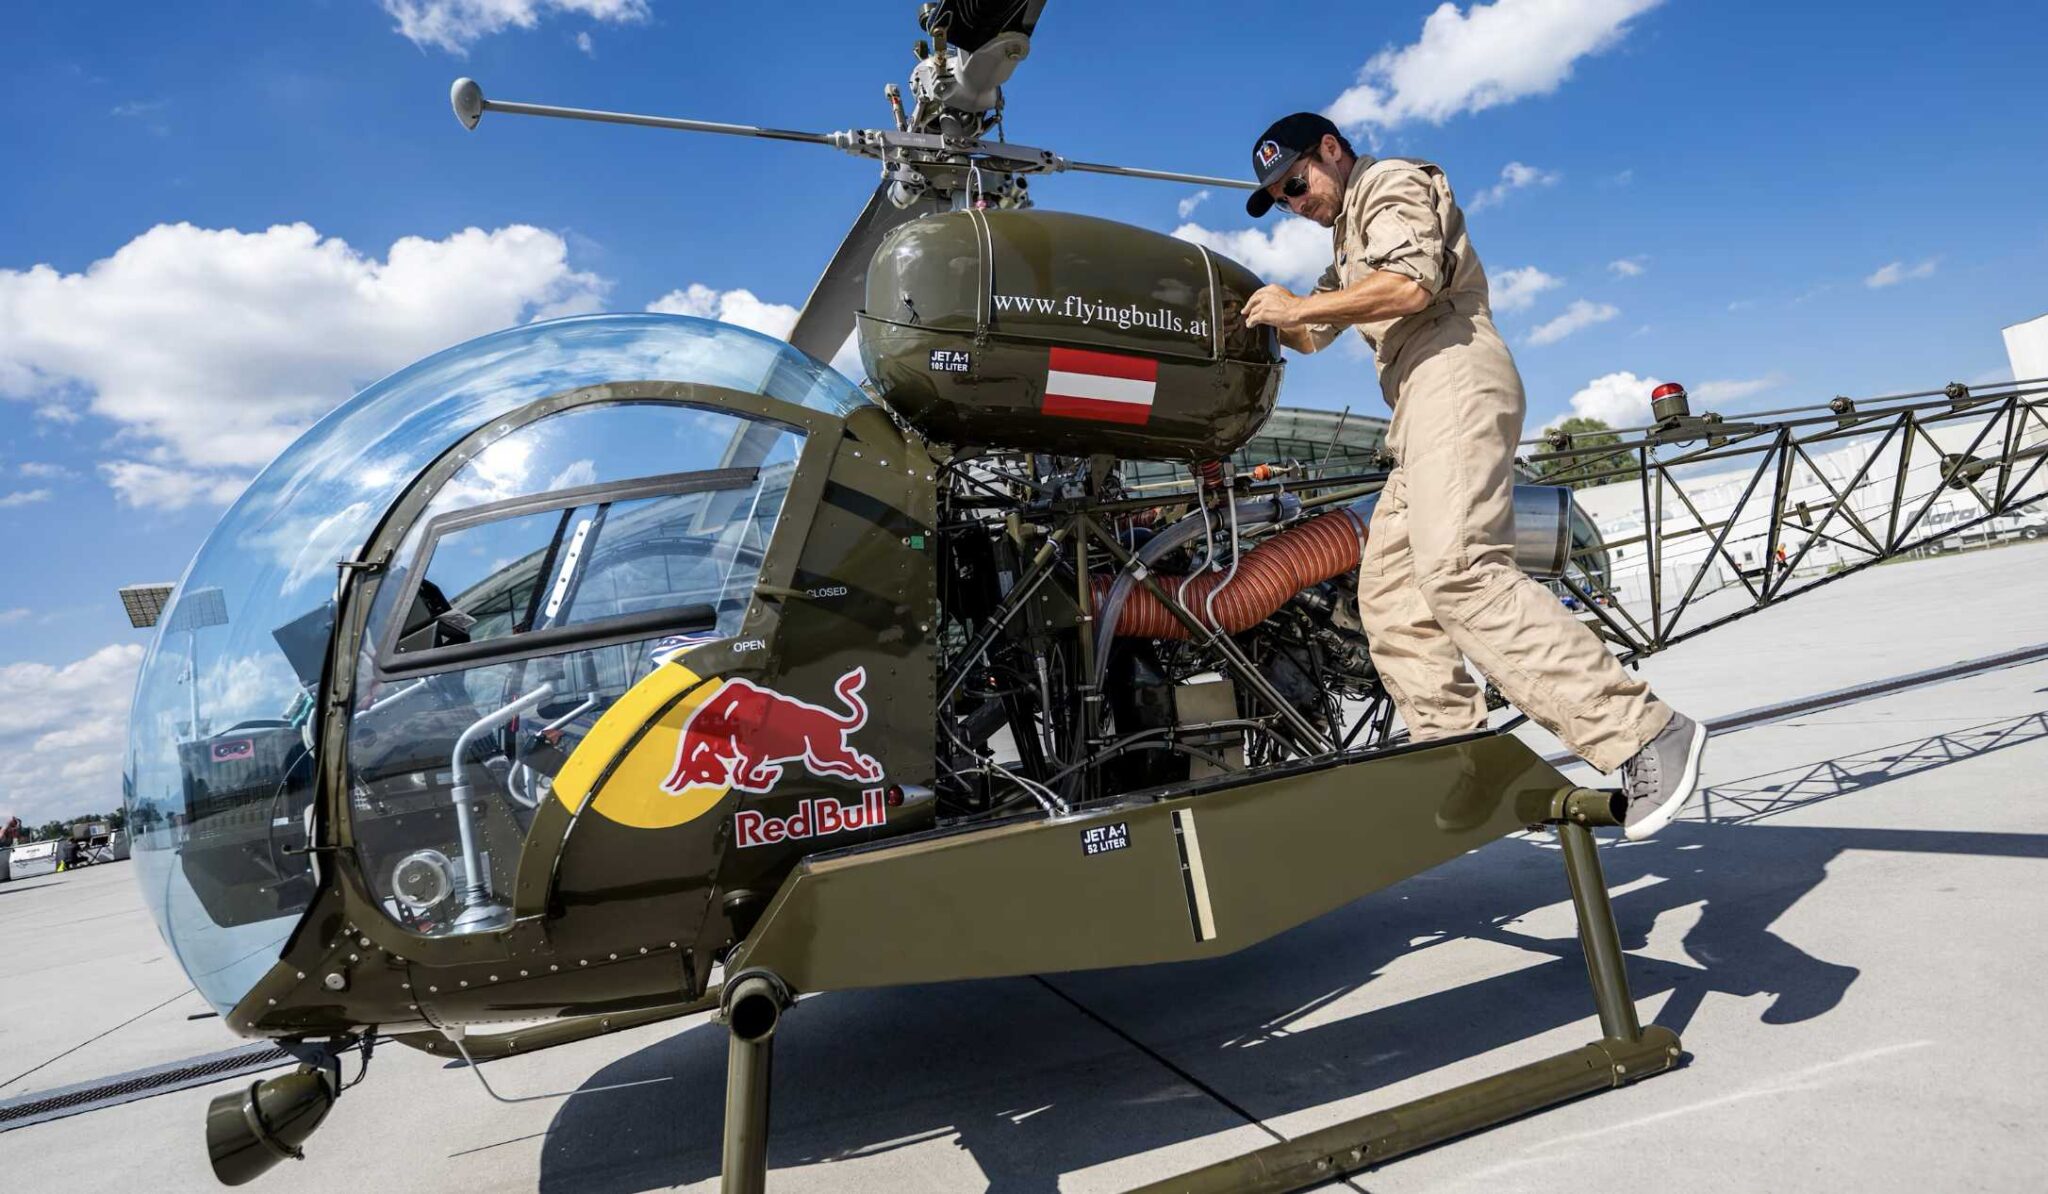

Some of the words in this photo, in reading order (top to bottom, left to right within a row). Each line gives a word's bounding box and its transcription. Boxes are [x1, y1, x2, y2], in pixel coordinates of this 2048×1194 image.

[992, 295, 1208, 337] www.flyingbulls.at
[931, 350, 952, 362] JET
[952, 351, 969, 363] A-1
[931, 362, 944, 370] 105
[945, 363, 968, 372] LITER
[733, 639, 766, 653] OPEN
[735, 799, 813, 848] Red
[814, 787, 887, 836] Bull
[1083, 828, 1107, 844] JET
[1108, 823, 1127, 839] A-1
[1087, 843, 1099, 854] 52
[1100, 837, 1127, 852] LITER
